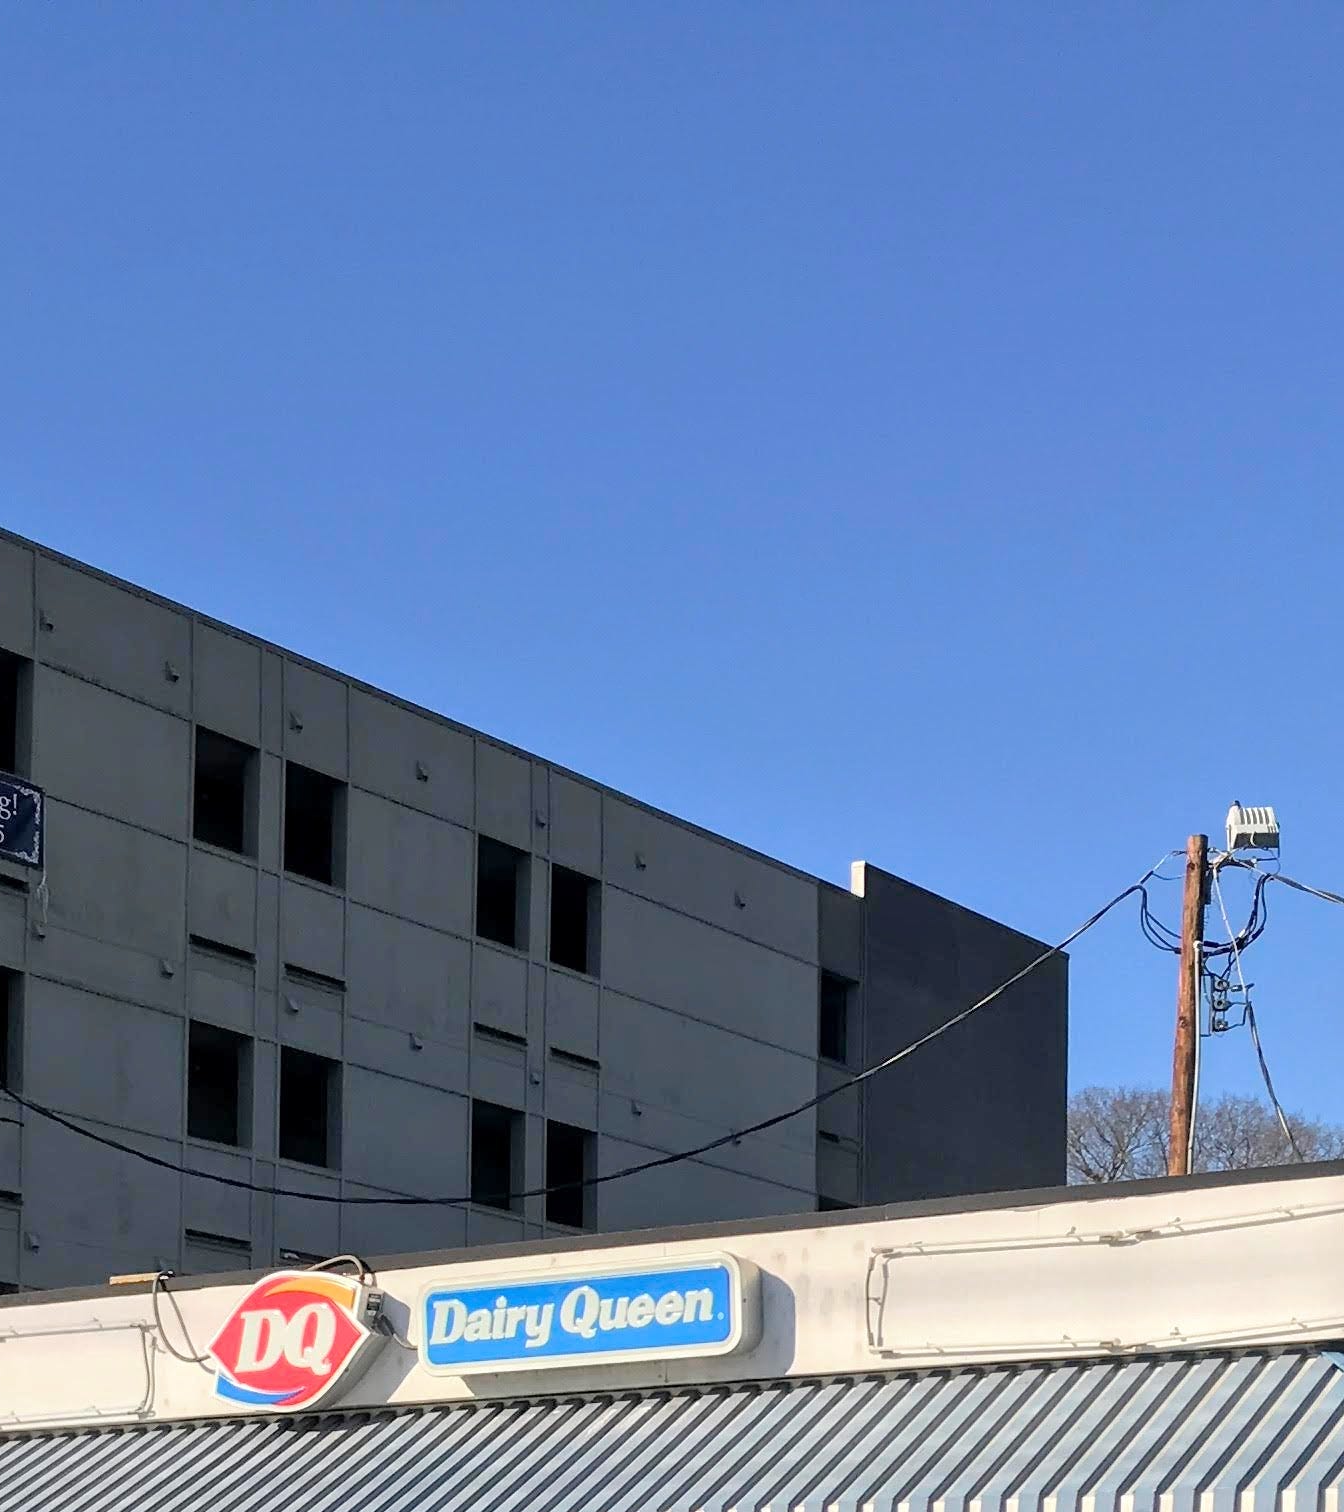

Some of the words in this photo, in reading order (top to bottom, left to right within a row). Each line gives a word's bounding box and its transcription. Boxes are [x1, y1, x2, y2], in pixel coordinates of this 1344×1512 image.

[234, 1304, 334, 1376] DQ
[429, 1296, 554, 1350] Dairy
[560, 1284, 715, 1340] Queen
